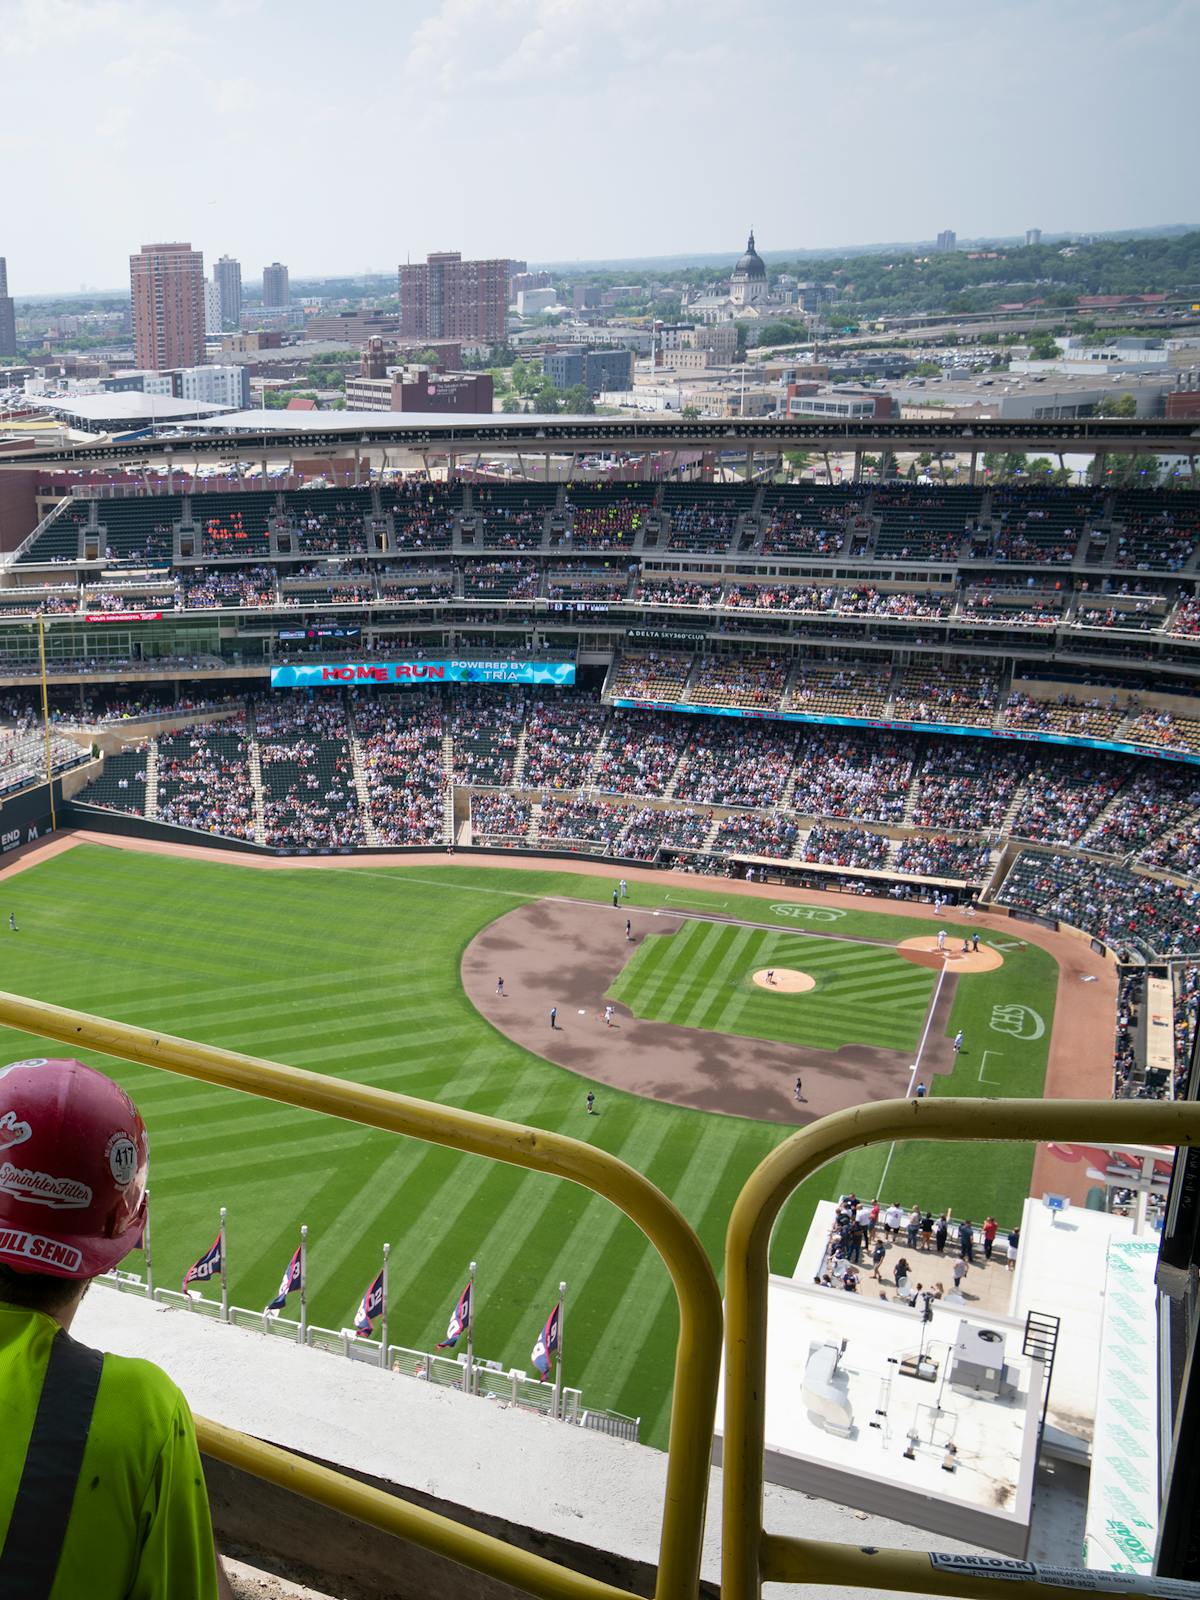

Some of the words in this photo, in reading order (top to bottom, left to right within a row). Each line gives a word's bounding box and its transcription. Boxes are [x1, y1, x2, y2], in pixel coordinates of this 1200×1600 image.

[636, 630, 659, 638] DELTA
[322, 665, 388, 681] HOME
[395, 664, 445, 679] RUN
[451, 661, 509, 670] POWERED
[511, 662, 526, 670] BY
[483, 670, 519, 681] TRIA
[1, 828, 21, 845] END
[777, 905, 838, 921] CHS
[115, 1147, 134, 1166] 417
[29, 1238, 80, 1267] SEND
[939, 1553, 1030, 1570] GARLOCK
